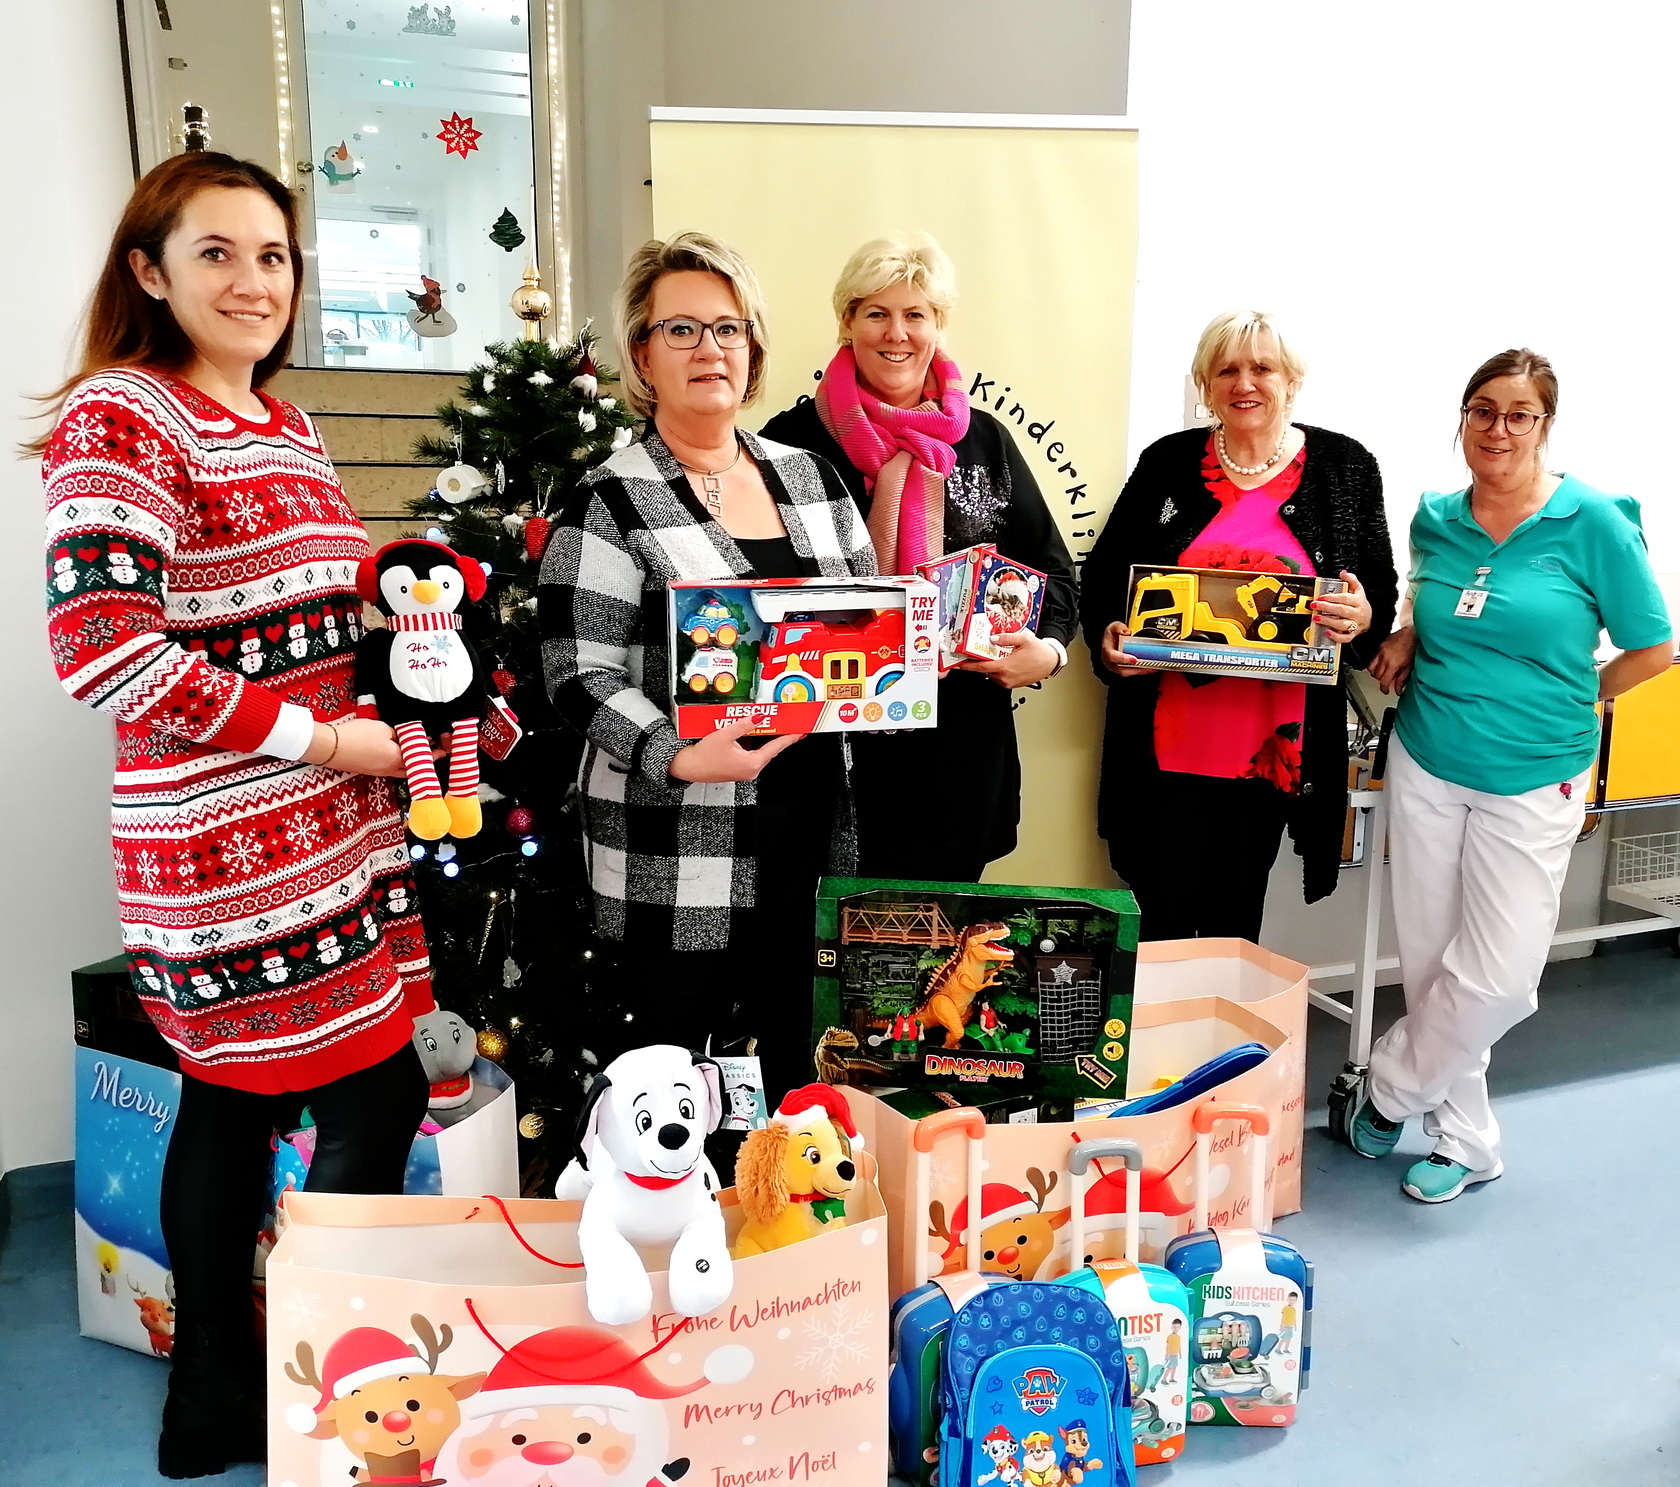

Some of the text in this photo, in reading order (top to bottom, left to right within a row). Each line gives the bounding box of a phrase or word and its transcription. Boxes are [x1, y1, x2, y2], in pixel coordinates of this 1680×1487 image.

[910, 596, 937, 608] TRY
[912, 609, 934, 621] ME
[406, 642, 430, 653] Ho
[1291, 647, 1330, 662] CM
[408, 658, 427, 670] Ho
[1170, 650, 1279, 668] MEGA TRANSPORTER
[725, 704, 779, 717] RESCUE
[916, 701, 926, 712] 3
[480, 723, 496, 741] TOY
[483, 719, 507, 743] DDLY
[819, 952, 834, 963] 3+
[720, 1061, 746, 1073] Disney
[925, 1054, 1025, 1079] DINOSAUR
[1080, 1057, 1099, 1073] TRY
[90, 1060, 171, 1134] Merry
[650, 1277, 862, 1344] Frohe Weihnachten
[1251, 1300, 1271, 1308] Series
[1116, 1312, 1164, 1337] NTIST
[1011, 1374, 1068, 1398] PAW
[684, 1377, 876, 1430] Merry Christmas
[1025, 1399, 1054, 1407] PATROL
[710, 1451, 836, 1487] Joyeux Noël
